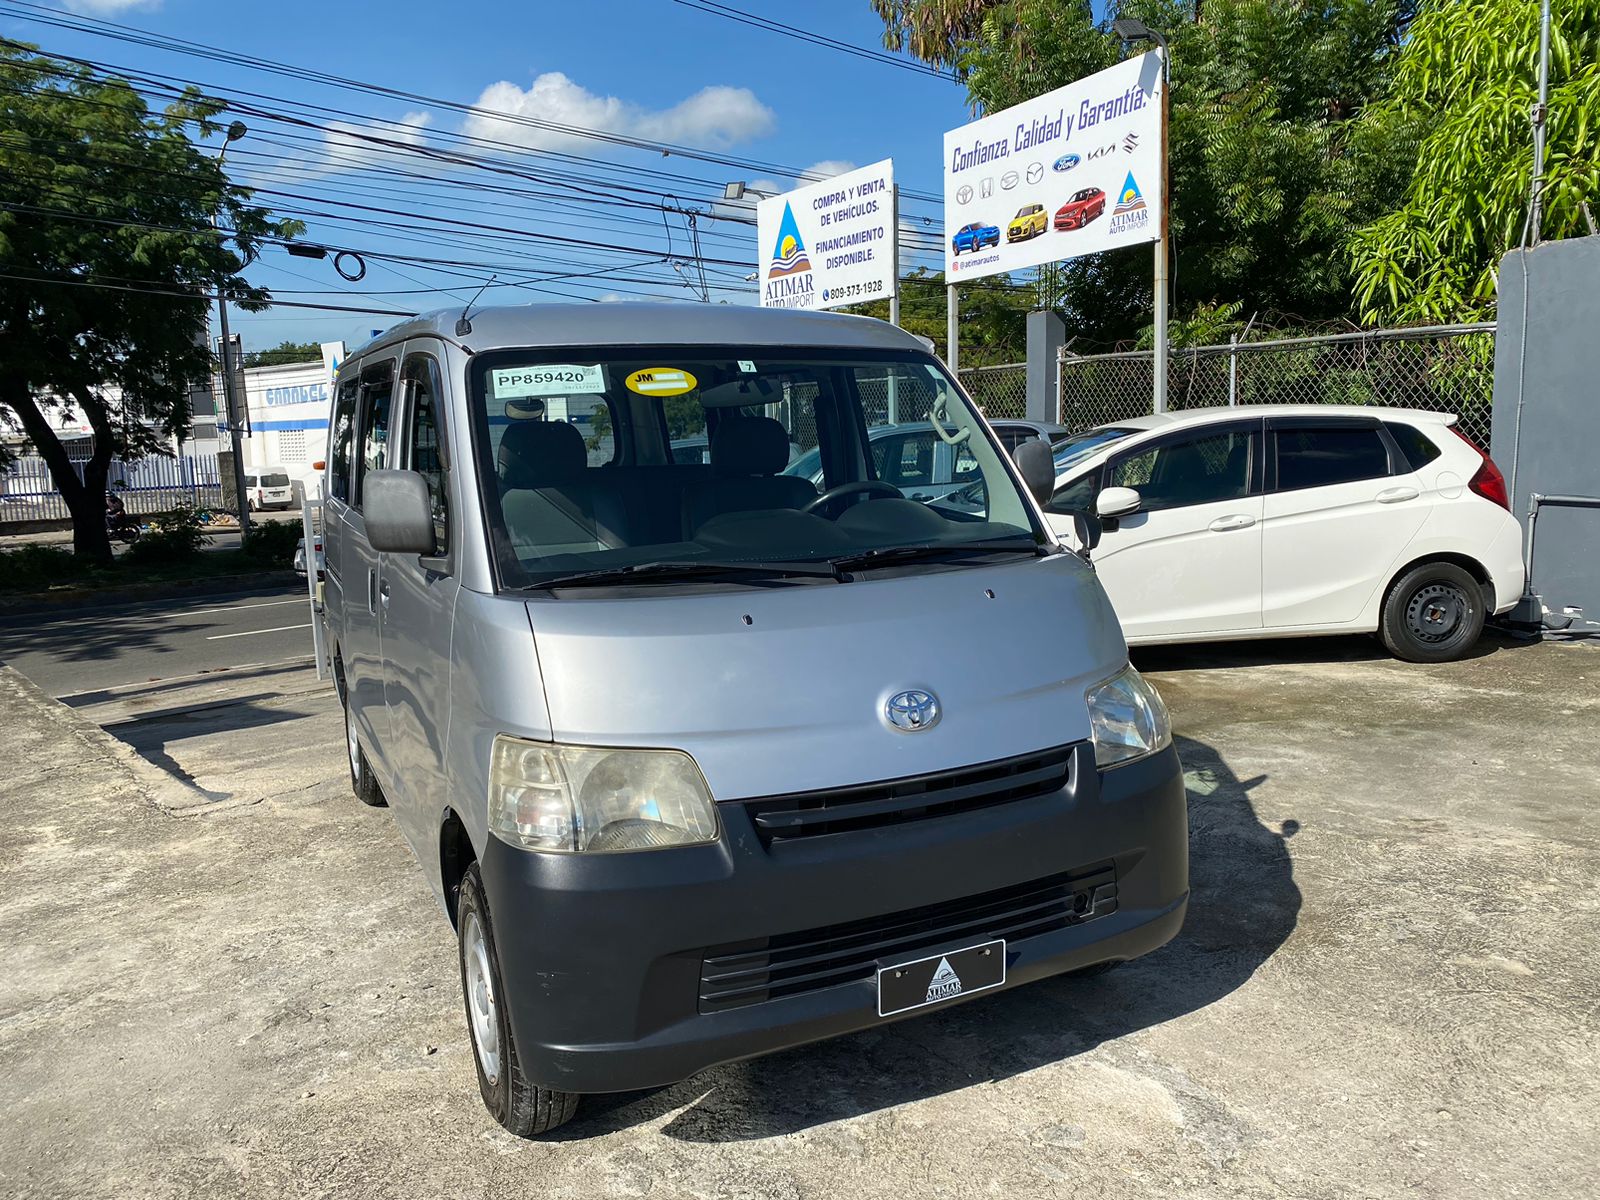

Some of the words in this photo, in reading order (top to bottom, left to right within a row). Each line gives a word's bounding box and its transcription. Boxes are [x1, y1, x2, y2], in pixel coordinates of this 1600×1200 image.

[952, 136, 1011, 173] Confianza,
[1014, 109, 1063, 152] Calidad
[1066, 113, 1075, 141] y
[1078, 85, 1147, 131] Garantía.
[813, 190, 847, 210] COMPRA
[848, 187, 855, 199] Y
[856, 178, 886, 198] VENTA
[820, 214, 831, 226] DE
[833, 200, 880, 222] VEHÍCULOS.
[1110, 209, 1148, 227] ATIMAR
[1109, 225, 1126, 235] AUTO
[1126, 219, 1149, 231] IMPORT
[815, 226, 884, 254] FINANCIAMIENTO
[826, 248, 875, 270] DISPONIBLE.
[765, 273, 815, 300] ATIMAR
[830, 280, 883, 300] 809-373-1928
[786, 293, 815, 308] IMPORT
[498, 372, 584, 386] PP859420
[635, 373, 653, 382] JM
[927, 982, 961, 998] ATIMAR
